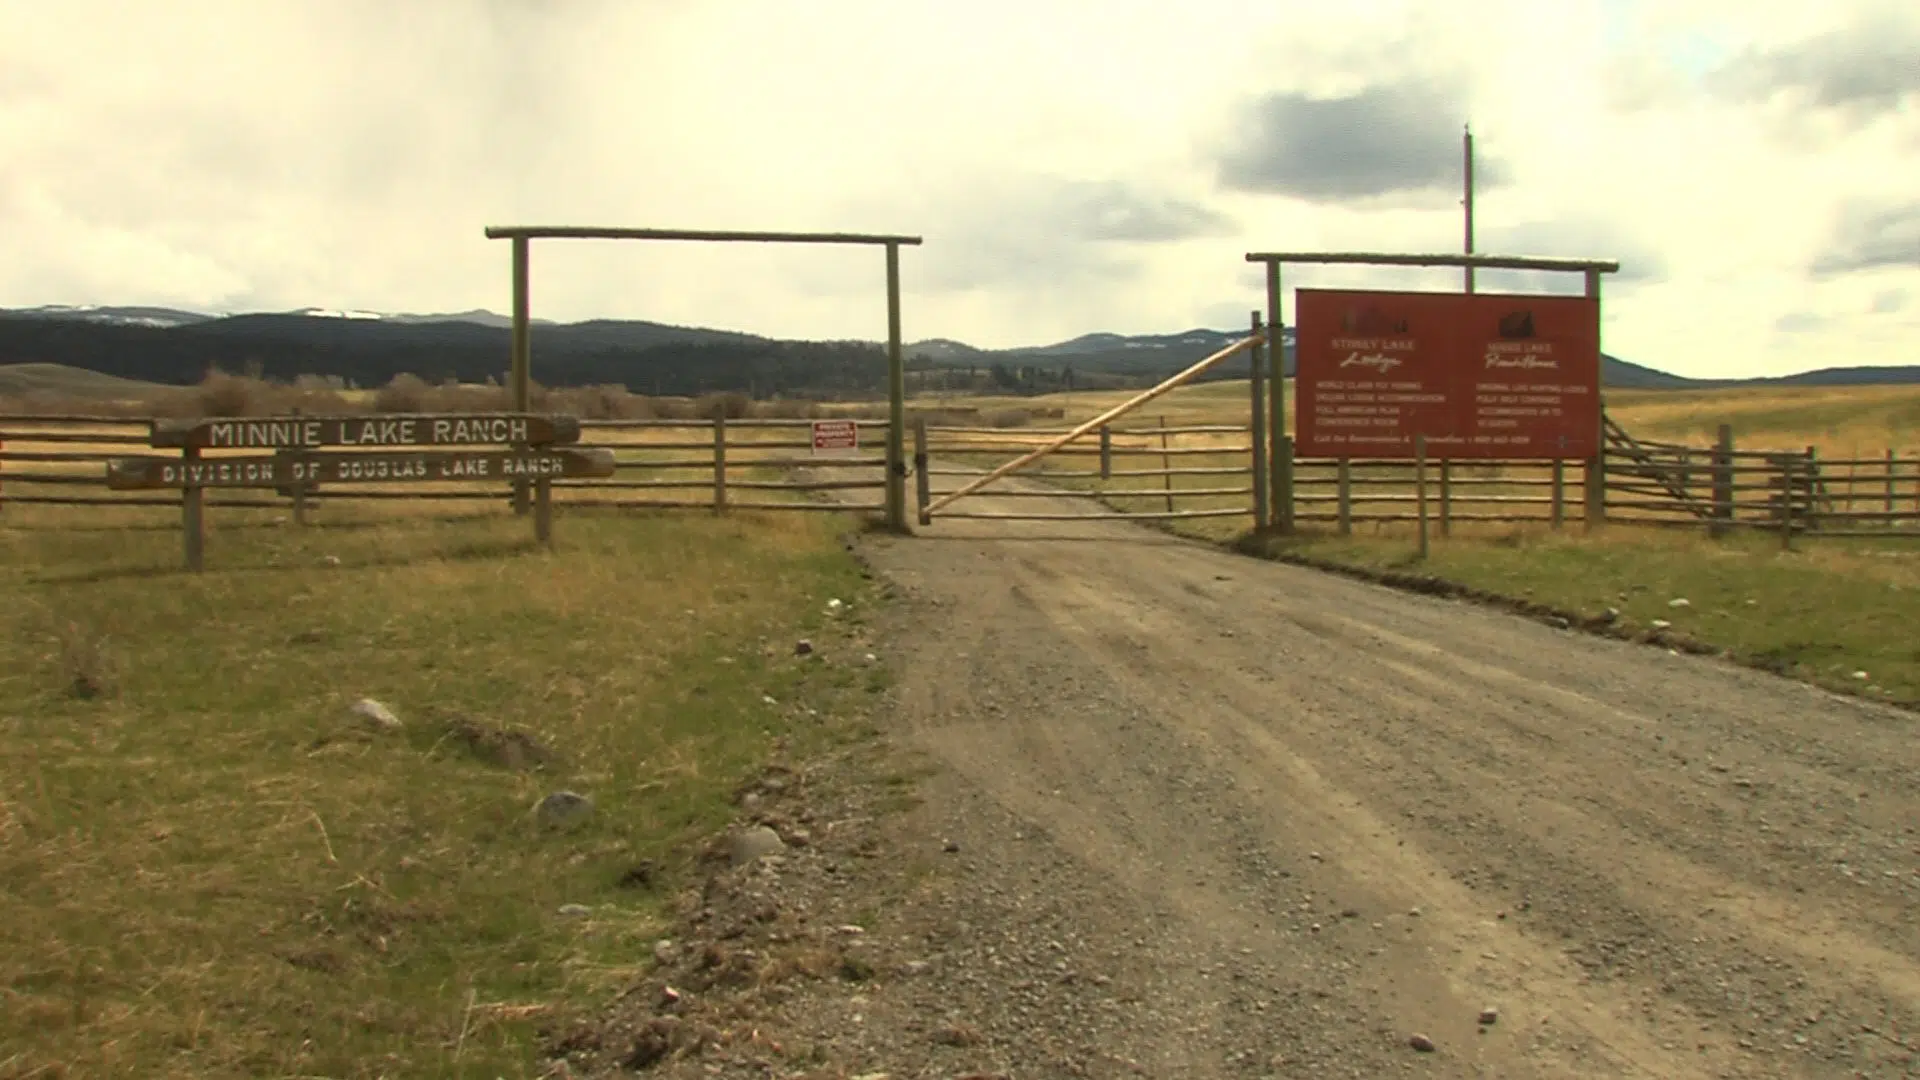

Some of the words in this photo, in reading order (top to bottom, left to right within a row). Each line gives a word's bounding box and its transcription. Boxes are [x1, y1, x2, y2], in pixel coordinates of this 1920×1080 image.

[210, 421, 322, 446] MINNIE
[339, 420, 417, 445] LAKE
[433, 419, 528, 443] RANCH
[162, 463, 274, 483] DIVISION
[292, 462, 321, 480] OF
[338, 459, 427, 479] DOUGLAS
[441, 458, 489, 477] LAKE
[503, 457, 564, 475] RANCH
